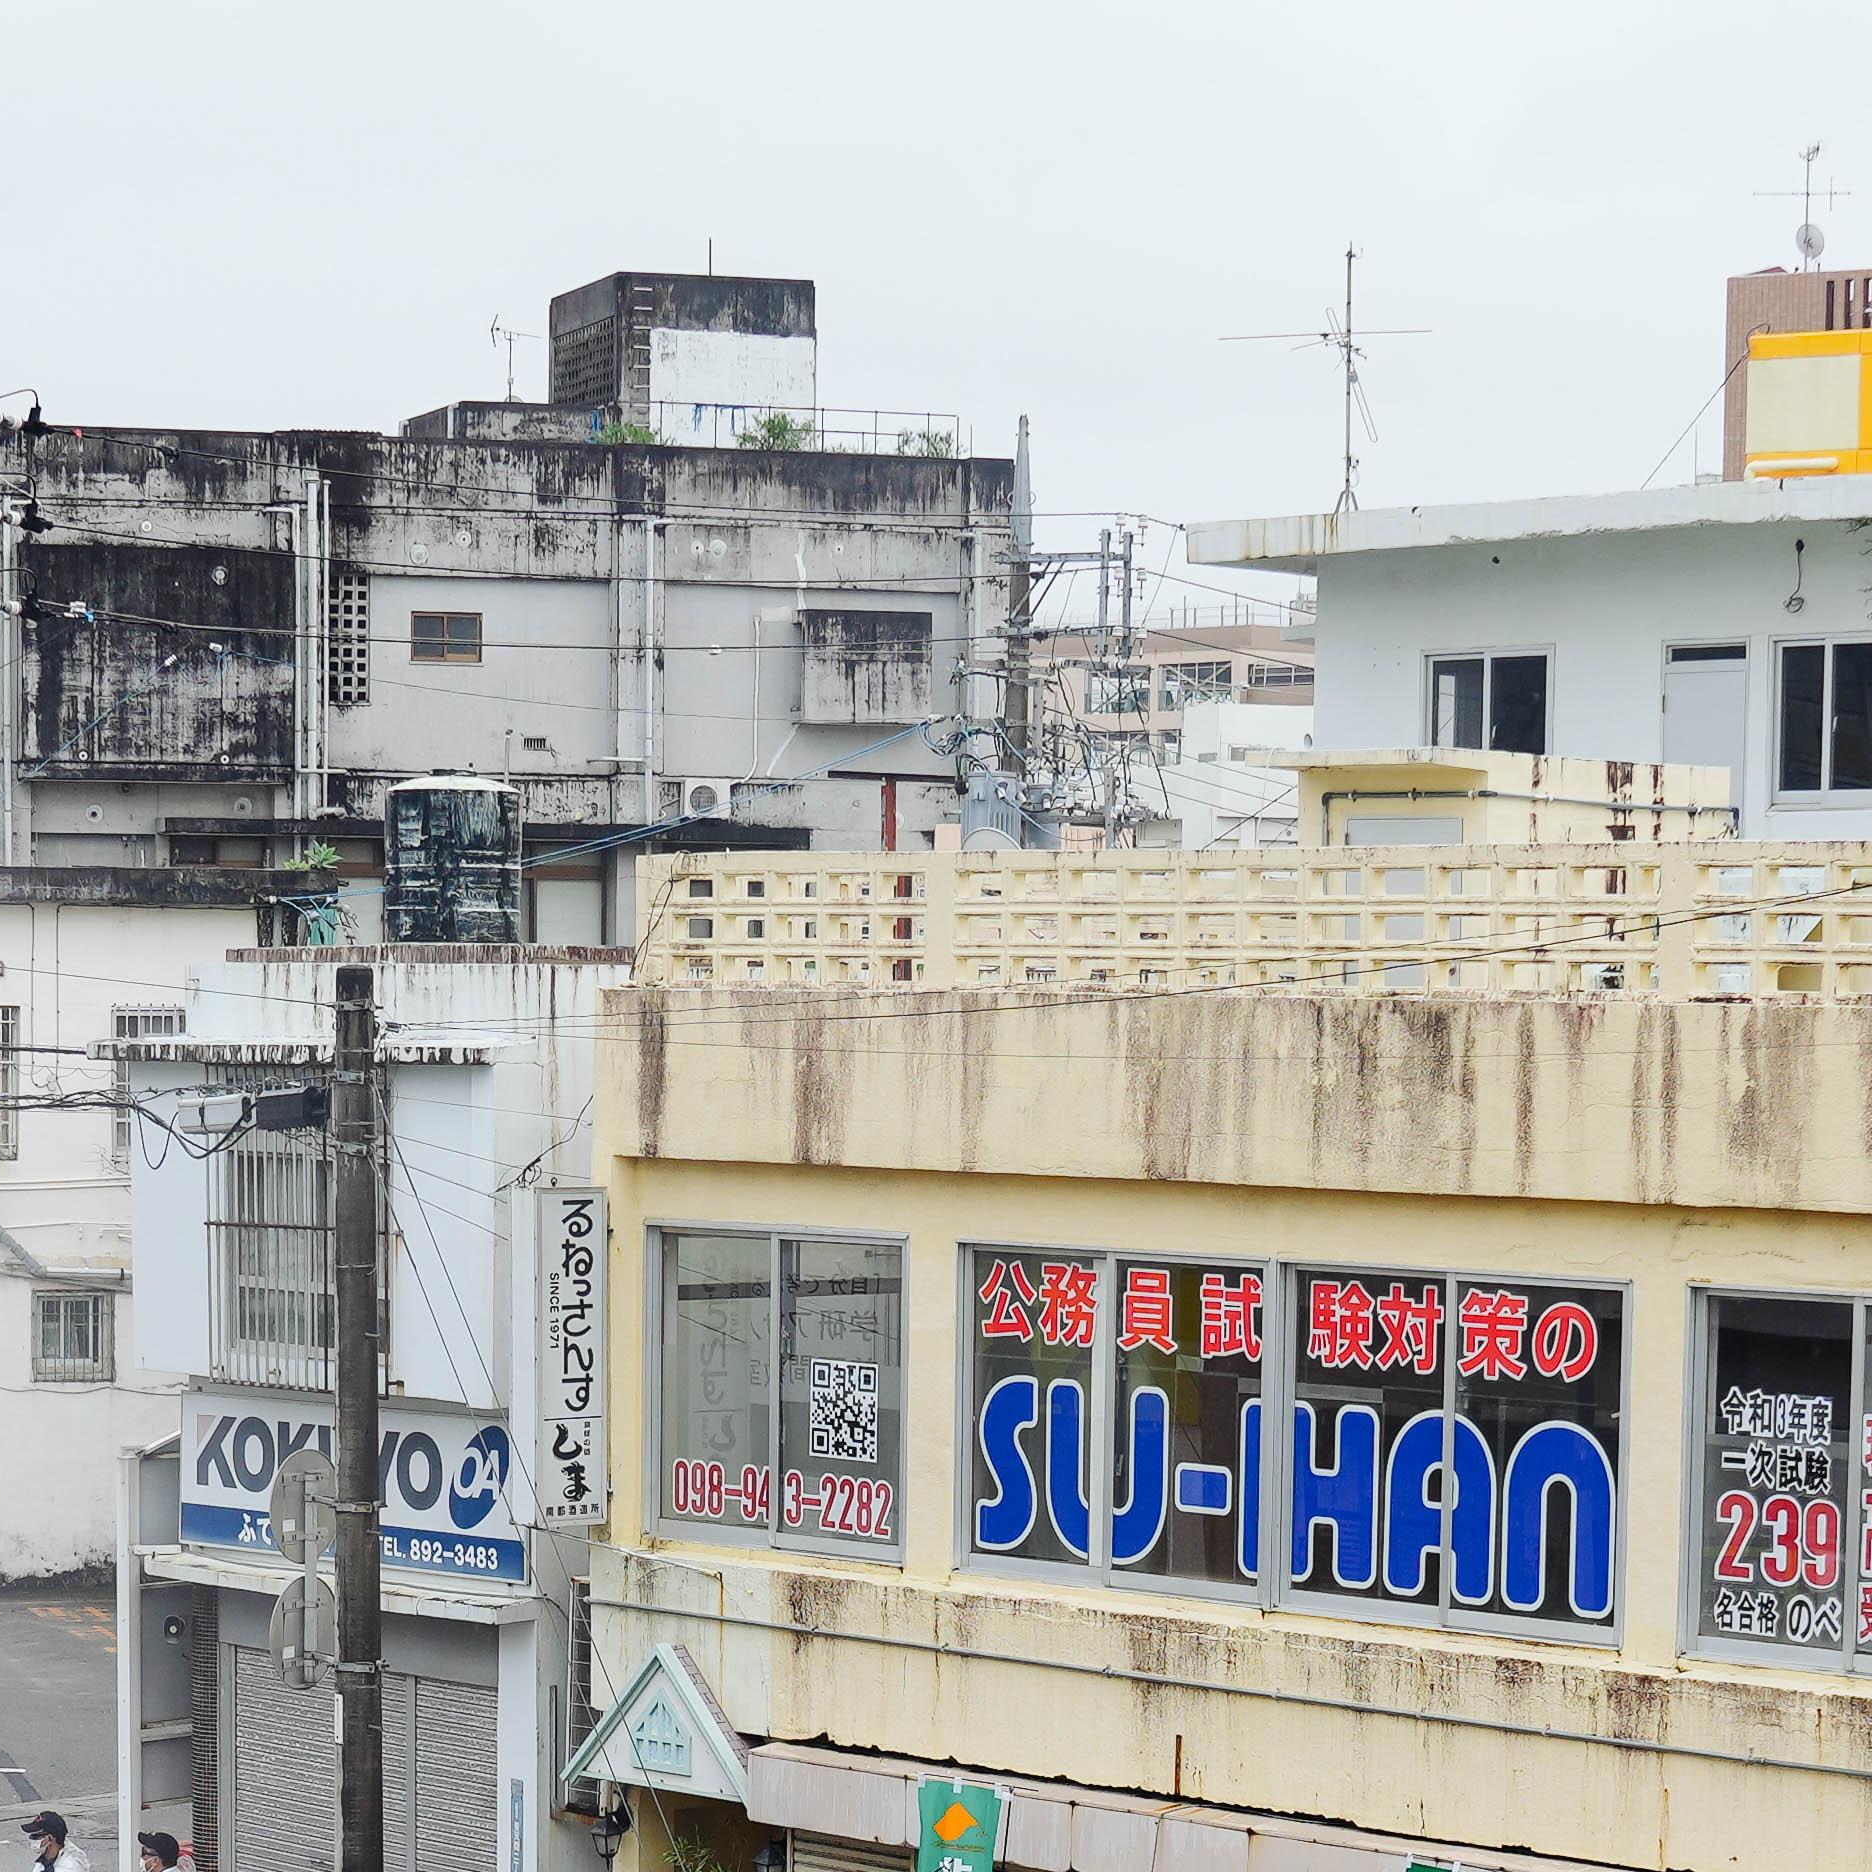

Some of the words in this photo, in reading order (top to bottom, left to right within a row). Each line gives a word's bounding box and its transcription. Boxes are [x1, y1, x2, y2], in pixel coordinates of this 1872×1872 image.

[550, 1272, 559, 1313] SINCE
[550, 1317, 559, 1350] 1971
[978, 1260, 1601, 1383] 公務員試験対策の
[1721, 1388, 1831, 1443] 令和3年度
[1721, 1444, 1830, 1493] 一次試験
[674, 1456, 894, 1541] 098-943-2282
[409, 1538, 499, 1571] 892-3483
[1718, 1493, 1839, 1587] 239
[1716, 1590, 1777, 1633] 名合格
[1789, 1596, 1841, 1640] のべ
